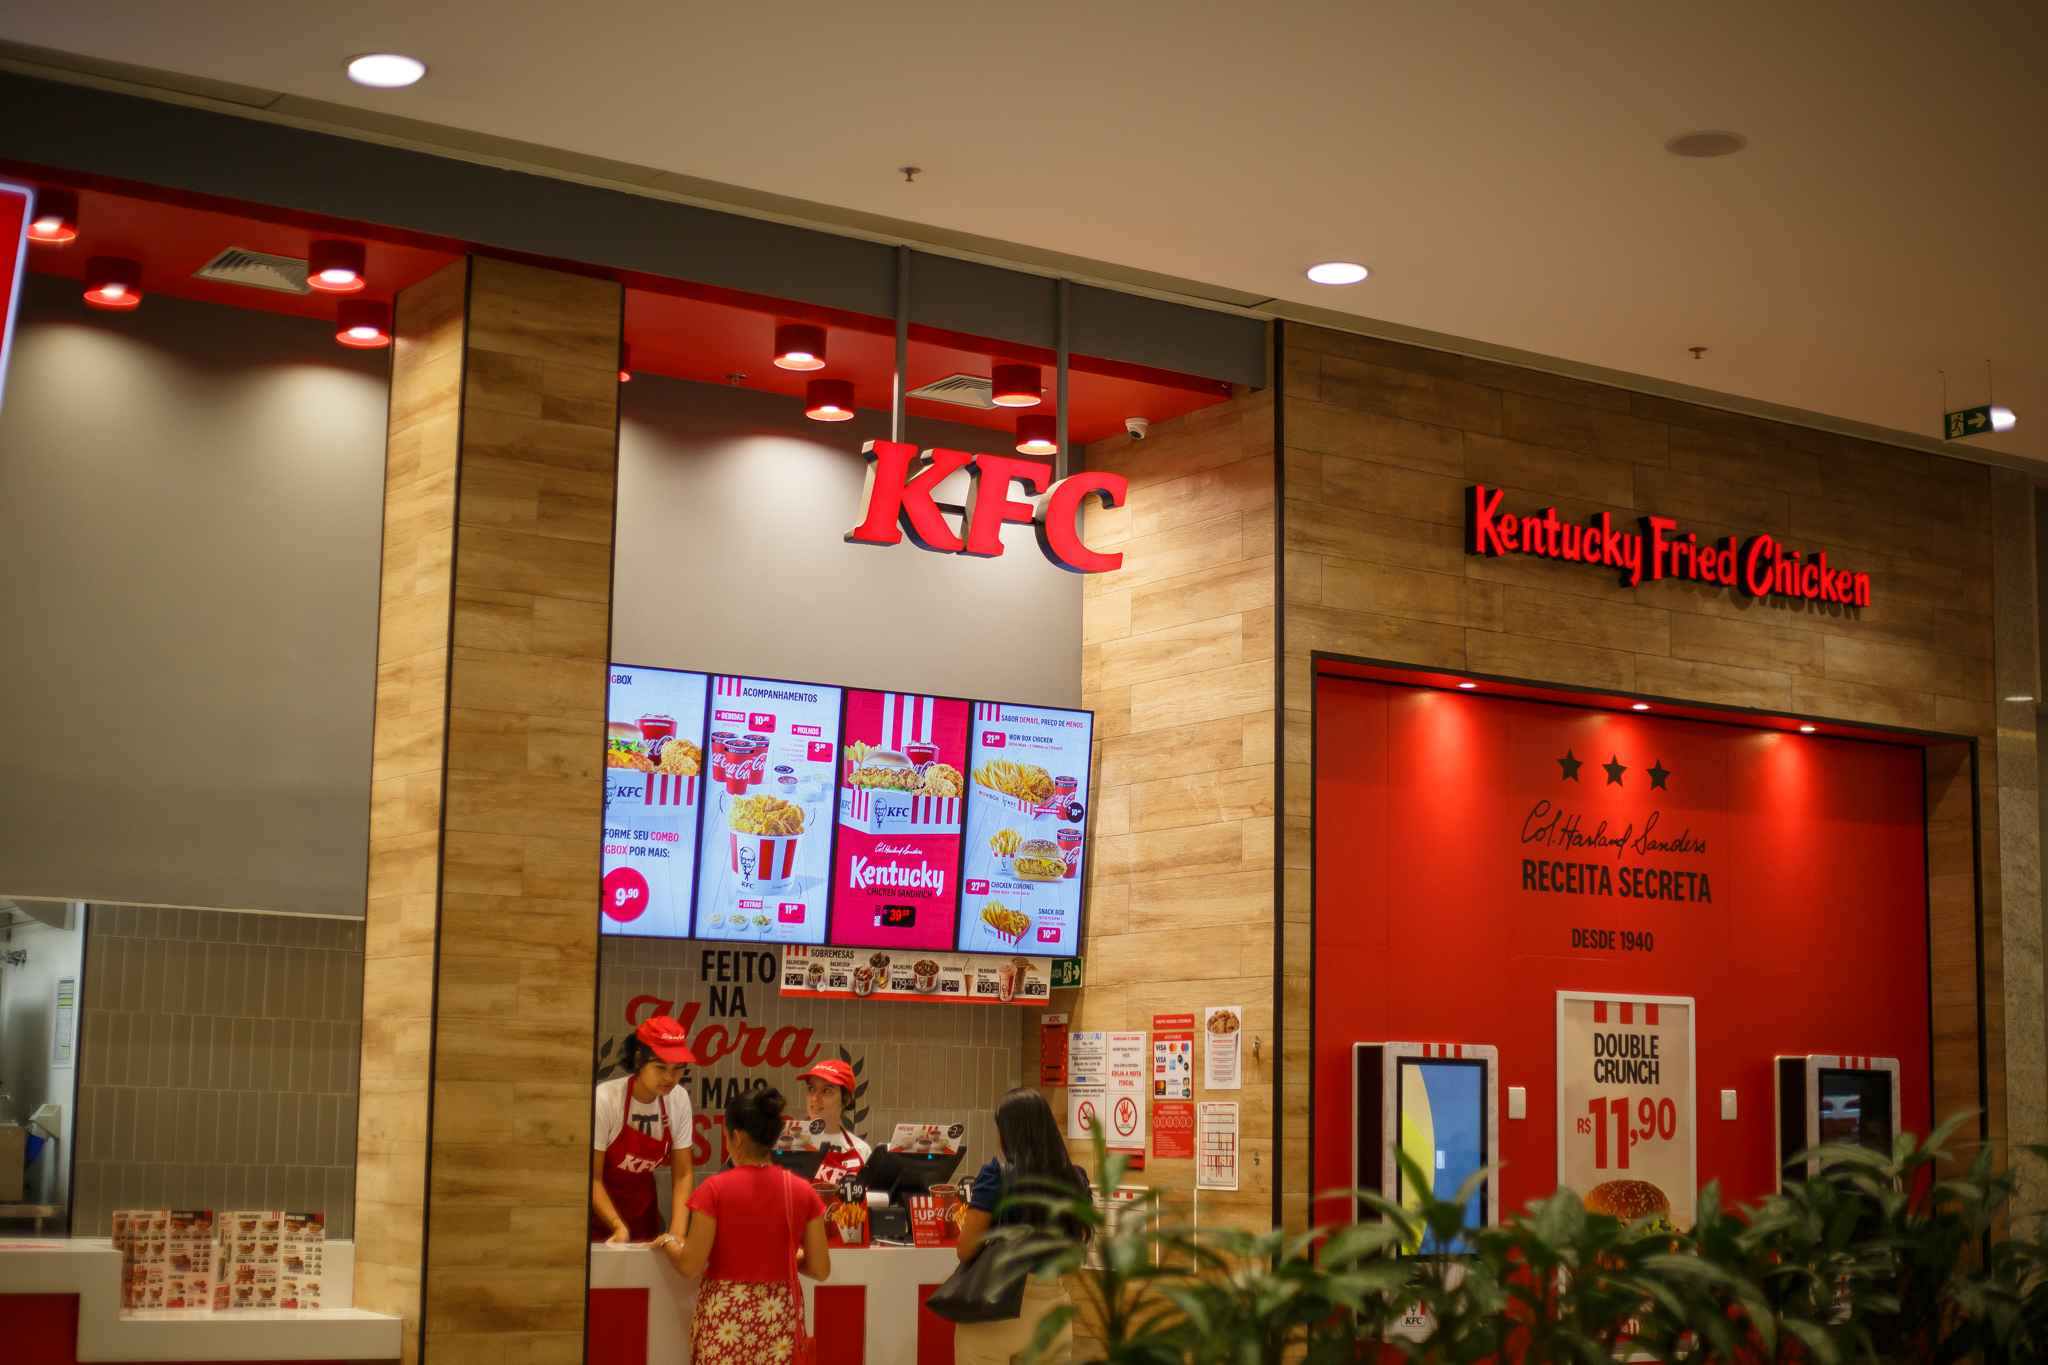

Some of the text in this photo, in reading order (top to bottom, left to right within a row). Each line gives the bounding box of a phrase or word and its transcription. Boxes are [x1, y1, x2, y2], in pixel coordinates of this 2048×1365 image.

[846, 439, 1129, 574] KFC
[1470, 485, 1871, 608] Kentucky Fried Chicken
[742, 687, 818, 703] ACOMPANHAMENTOS
[721, 712, 744, 721] BEBIDAS
[1001, 714, 1019, 723] SABOR
[1019, 716, 1041, 726] DEMAIS,
[1041, 718, 1058, 728] PREÇO
[1066, 721, 1084, 729] MENOS
[797, 726, 820, 736] MOLHOS
[1009, 733, 1021, 741] WOW
[1032, 736, 1053, 744] CHICKEN
[616, 786, 643, 798] KFC
[886, 806, 910, 817] KFC
[1007, 800, 1017, 808] KFC
[633, 830, 649, 840] SEU
[650, 831, 680, 843] COMBO
[1559, 814, 1633, 860] Harland
[1631, 811, 1706, 856] Sanders
[629, 846, 646, 857] POR
[648, 847, 671, 859] MAIS:
[849, 855, 945, 897] Kentucky
[1522, 858, 1712, 904] RECEITA SECRETA
[741, 880, 755, 890] KFC
[991, 881, 1035, 891] CHICKEN CORONEL
[615, 887, 639, 907] 9,90
[867, 887, 933, 899] CHICKEN SANDWICH
[1572, 928, 1654, 952] DESDE 1940
[811, 948, 855, 959] SOBREMESAS
[701, 950, 777, 984] FEITO
[709, 985, 747, 1018] NA
[1049, 1015, 1061, 1023] KFC
[625, 994, 822, 1068] Hora
[1095, 1032, 1102, 1040] RJ
[1594, 1033, 1660, 1059] DOUBLE
[1594, 1058, 1660, 1085] CRUNCH
[1577, 1096, 1677, 1170] R$ 11,90
[617, 1154, 664, 1173] KFC
[814, 1164, 857, 1185] KF
[845, 1182, 863, 1202] 1,90
[918, 1209, 935, 1221] UP
[1404, 1316, 1423, 1326] KFC
